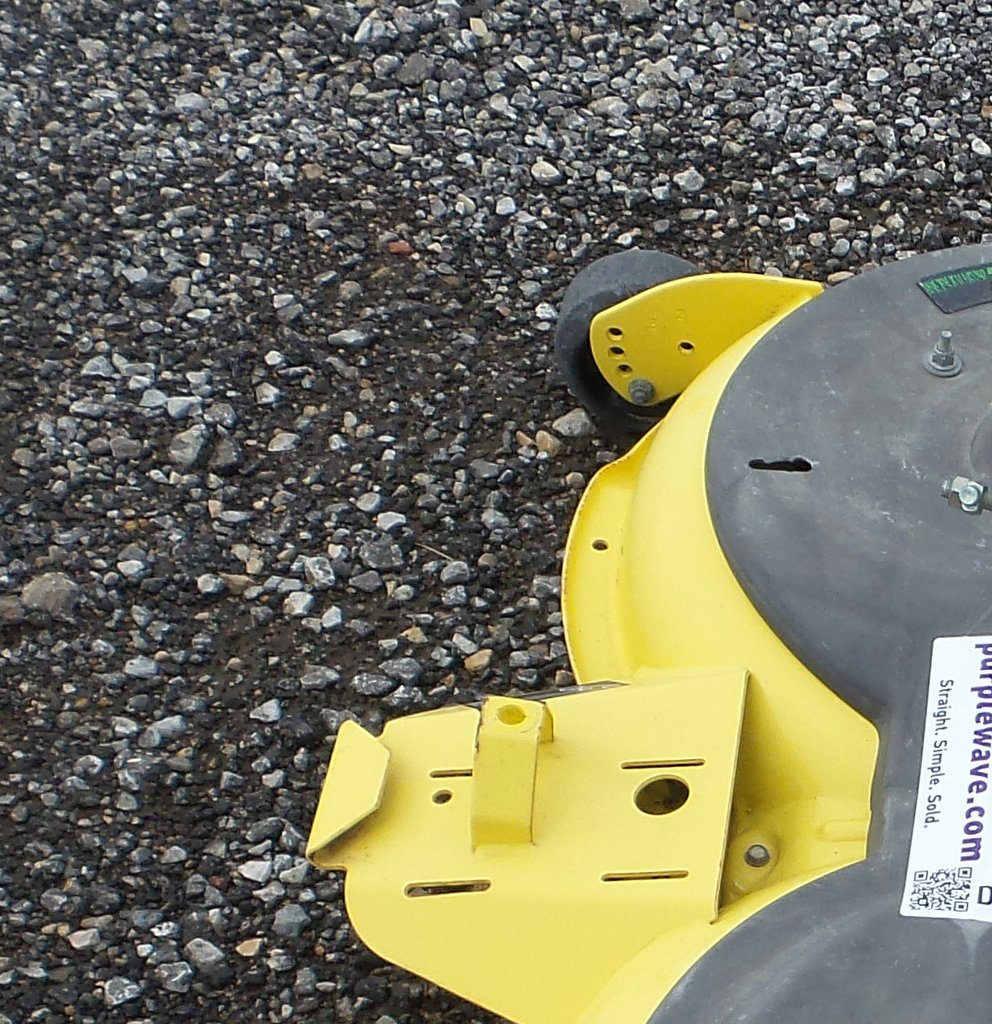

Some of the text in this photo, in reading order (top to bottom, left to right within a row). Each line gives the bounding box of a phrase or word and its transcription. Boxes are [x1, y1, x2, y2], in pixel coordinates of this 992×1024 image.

[923, 679, 954, 829] Straight. Simple. Sold.
